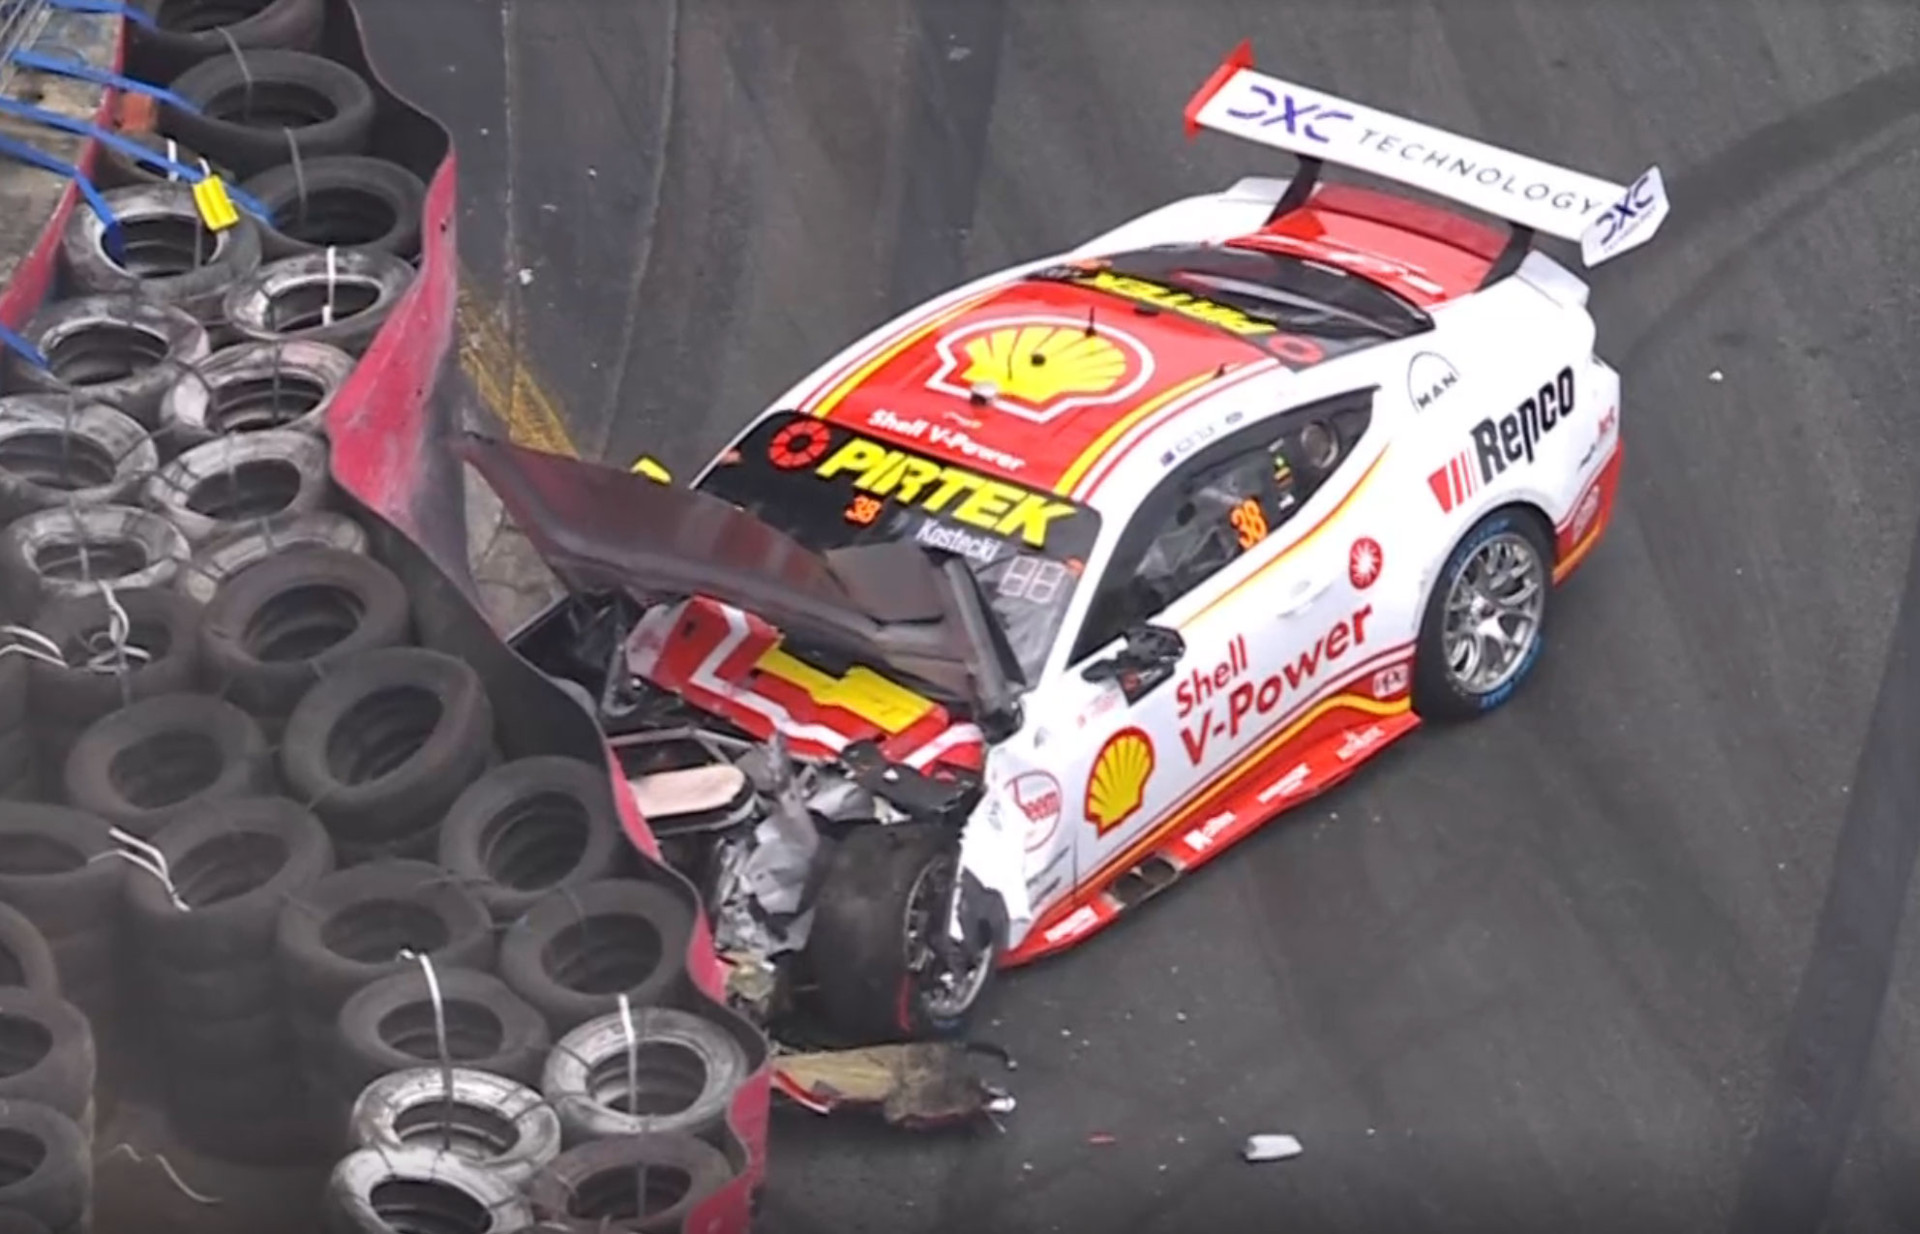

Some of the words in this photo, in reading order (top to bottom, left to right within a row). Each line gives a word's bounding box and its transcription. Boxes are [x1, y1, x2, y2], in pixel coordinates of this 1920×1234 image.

[1357, 128, 1603, 216] TECHNOLOGY
[1417, 372, 1458, 409] MAN
[1469, 365, 1574, 486] Repco
[868, 408, 922, 438] Shell
[928, 421, 1026, 471] V-Power
[815, 436, 1078, 548] PIRTEK
[844, 494, 883, 525] 38
[1230, 498, 1269, 550] 38
[915, 518, 1004, 563] Kostecki
[1175, 632, 1248, 720] Shell
[1179, 602, 1374, 767] V-Power
